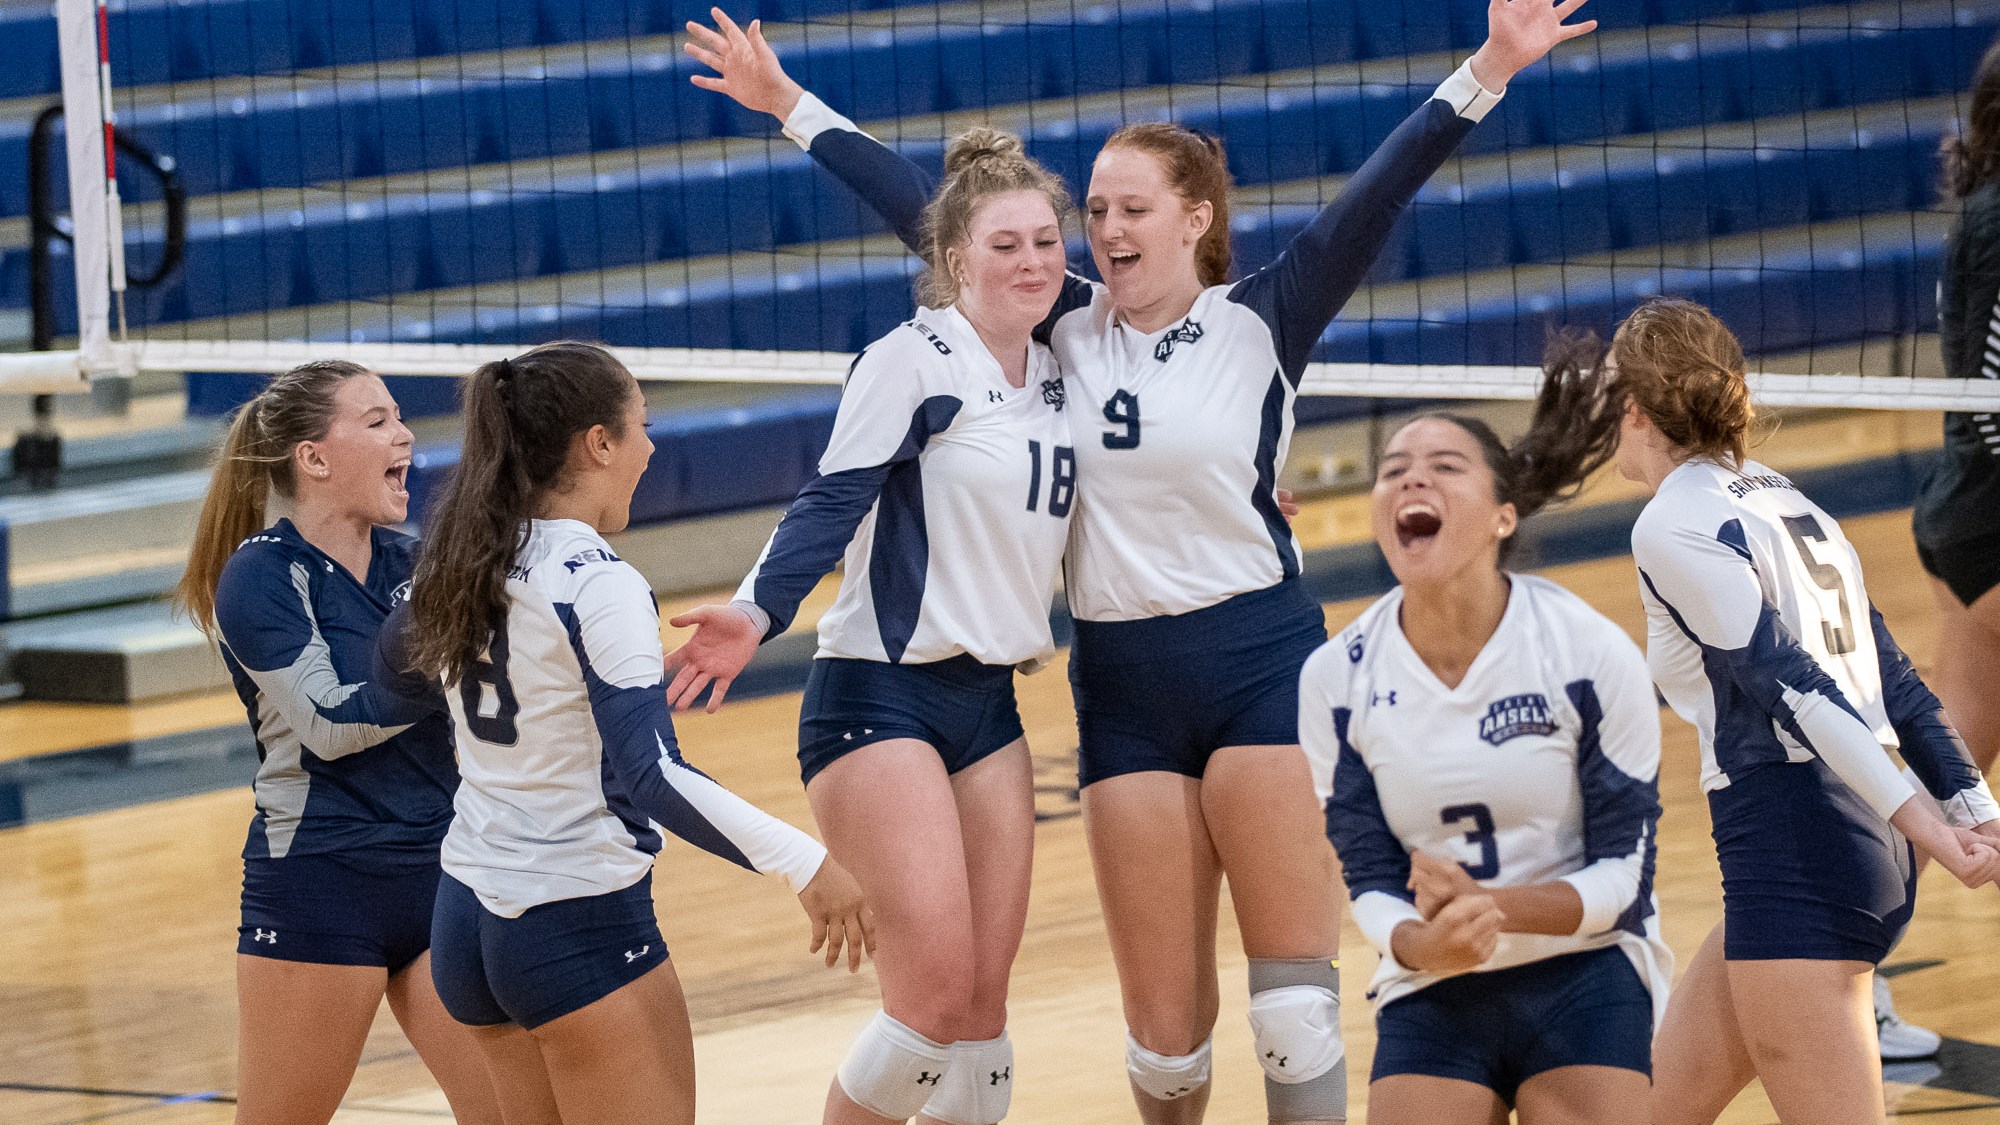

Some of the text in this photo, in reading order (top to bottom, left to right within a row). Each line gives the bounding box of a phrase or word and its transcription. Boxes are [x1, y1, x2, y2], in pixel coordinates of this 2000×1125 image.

[1102, 388, 1141, 450] 9
[1026, 438, 1077, 518] 18
[1779, 512, 1857, 656] 5
[458, 602, 521, 747] 8
[1440, 803, 1499, 880] 3
